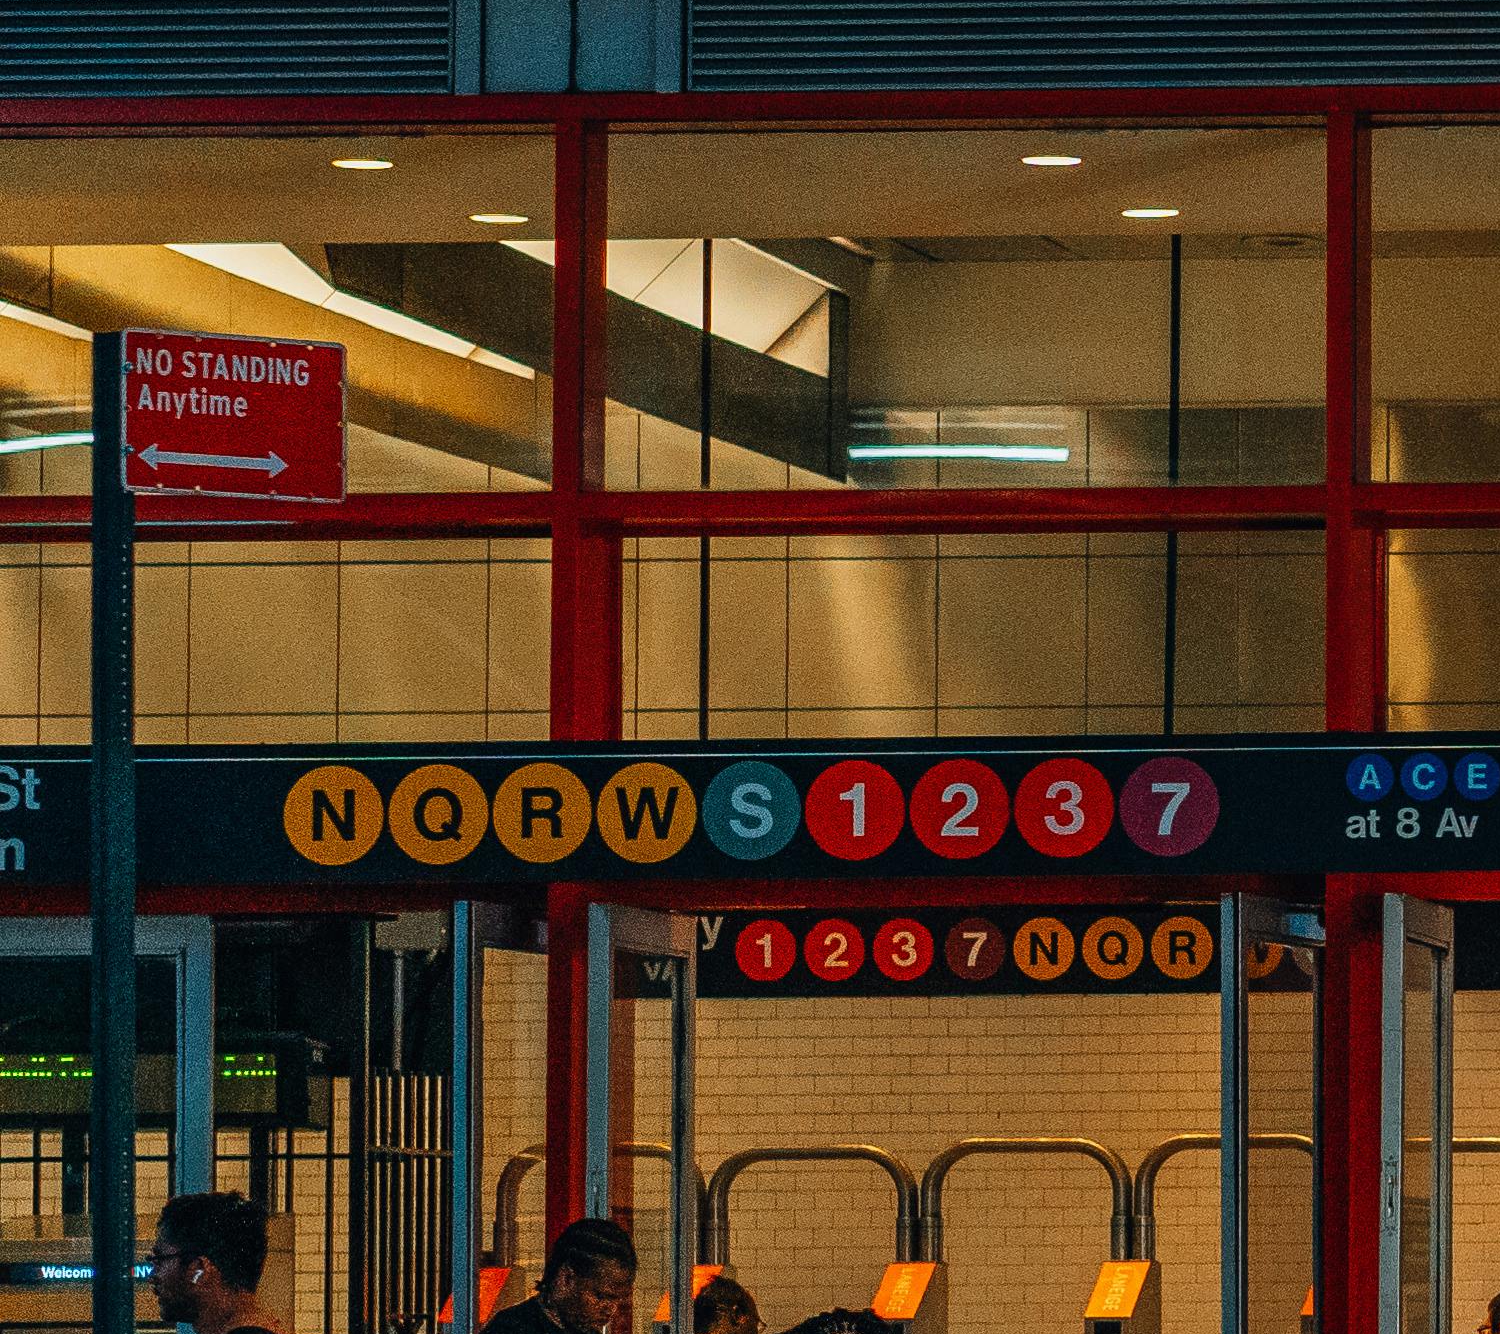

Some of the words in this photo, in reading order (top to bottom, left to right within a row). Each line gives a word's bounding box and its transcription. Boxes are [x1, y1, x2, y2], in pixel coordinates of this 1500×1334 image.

[136, 347, 173, 376] NO
[181, 351, 310, 386] STANDING
[137, 383, 249, 419] Anytime
[1357, 764, 1383, 790] A
[1412, 763, 1438, 790] C
[1467, 763, 1489, 789] E
[311, 789, 357, 841] N
[412, 788, 464, 841] Q
[520, 788, 565, 839] R
[615, 787, 678, 839] W
[729, 782, 775, 841] S
[840, 783, 866, 838] 1
[940, 781, 980, 838] 2
[1044, 780, 1086, 836] 3
[1152, 781, 1192, 836] 7
[1345, 810, 1381, 839] at
[1397, 808, 1421, 839] 8
[1436, 808, 1479, 839] Av
[755, 932, 773, 968] 1
[823, 931, 849, 968] 2
[891, 931, 917, 967] 3
[962, 931, 989, 967] 7
[1029, 930, 1061, 966] N
[1097, 930, 1132, 969] Q
[1168, 928, 1199, 965] R
[41, 1266, 96, 1280] Welcom
[1102, 1266, 1134, 1312] LANEIGE
